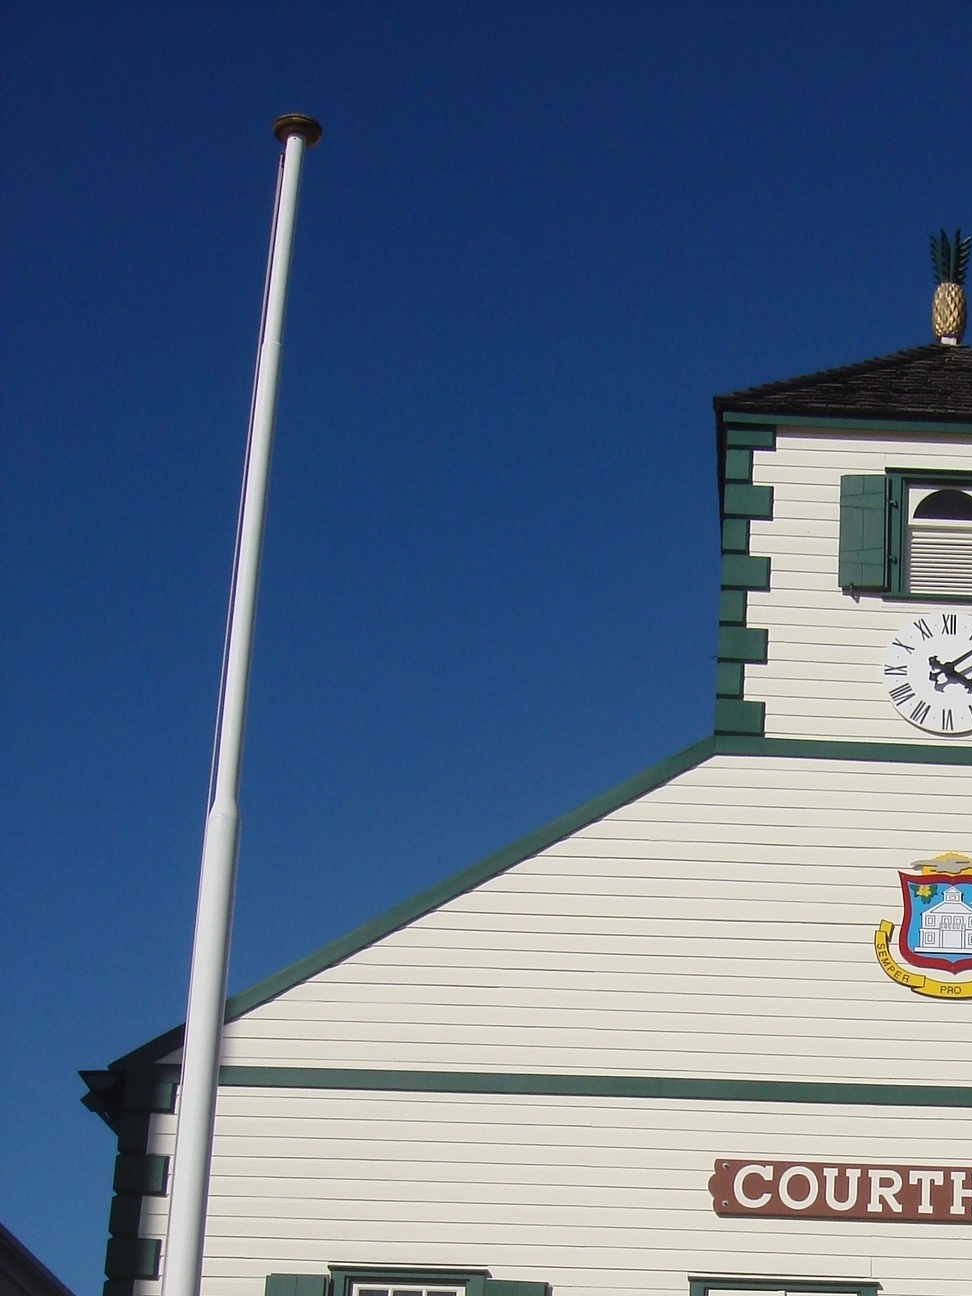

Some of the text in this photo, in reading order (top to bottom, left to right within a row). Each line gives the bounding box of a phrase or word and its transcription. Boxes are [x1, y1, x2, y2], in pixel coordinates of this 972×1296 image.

[913, 618, 933, 641] XI
[941, 613, 957, 635] XII
[891, 637, 915, 655] X
[884, 664, 908, 676] IX
[888, 683, 916, 706] VIII
[909, 700, 931, 725] VII
[942, 709, 954, 730] VI
[876, 943, 911, 983] SEMPER
[940, 985, 962, 994] PRO
